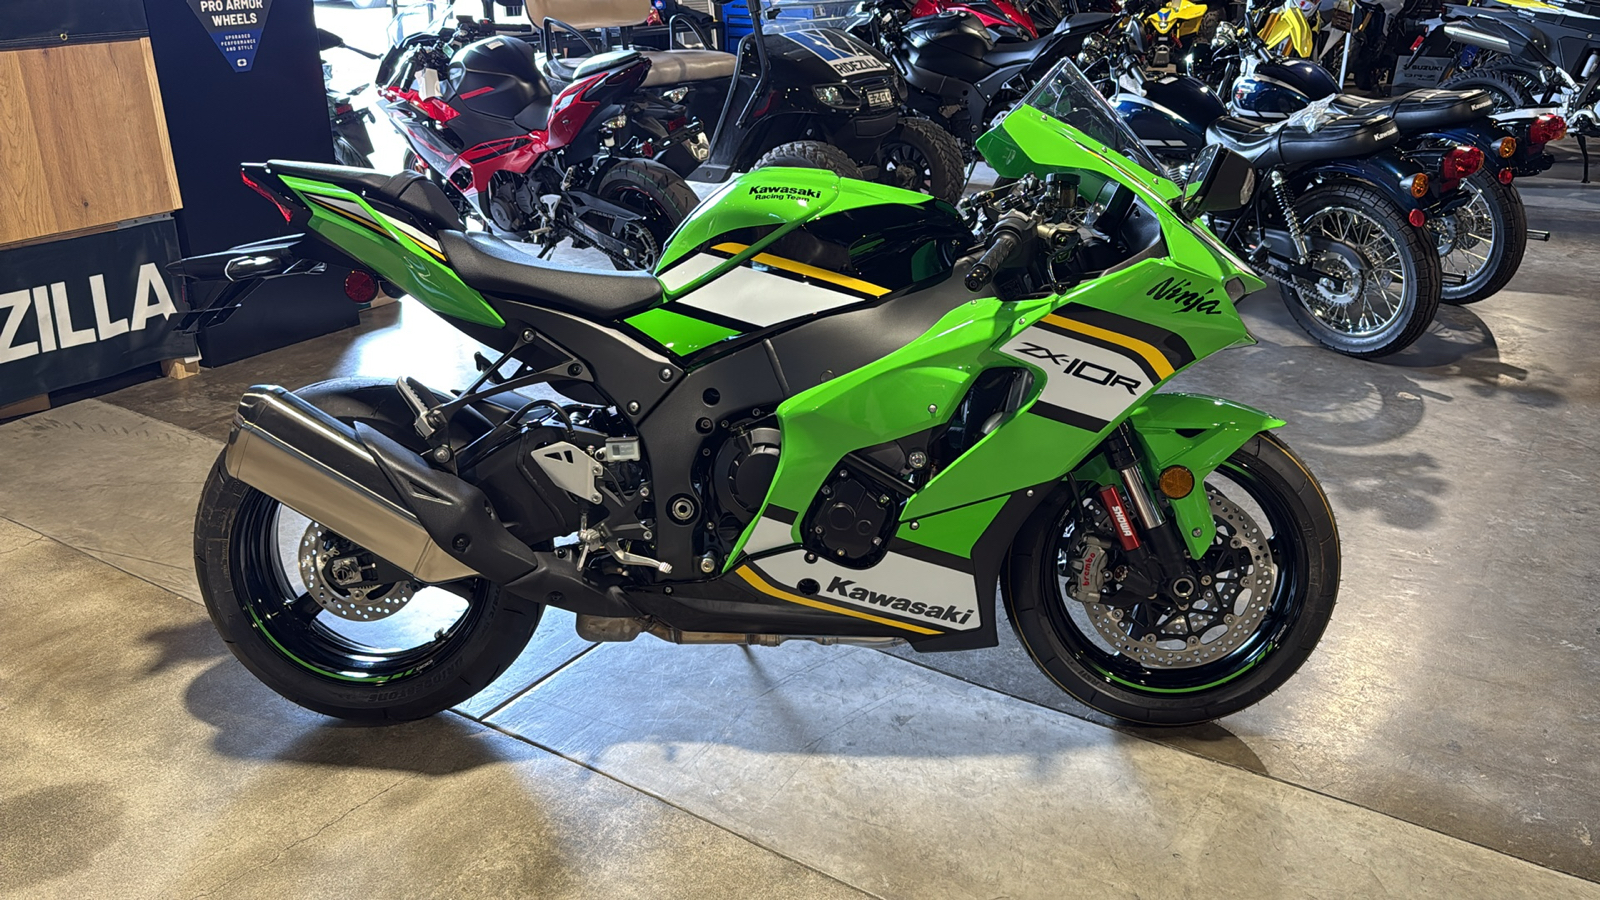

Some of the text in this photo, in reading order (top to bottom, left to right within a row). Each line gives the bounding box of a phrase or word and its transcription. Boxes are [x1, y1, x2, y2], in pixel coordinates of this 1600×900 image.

[200, 0, 263, 12] PRO ARMOR
[211, 12, 258, 27] WHEELS
[220, 38, 256, 47] PERFORMANCE
[225, 33, 251, 41] UPGRADED
[832, 58, 884, 75] RIDEZILLA
[749, 185, 821, 199] Kawasaki
[755, 193, 810, 202] Racing Team
[1146, 276, 1223, 315] Ninja
[0, 262, 178, 365] ZILLA
[1014, 341, 1142, 396] ZX-10R
[1111, 505, 1132, 537] SHOWA
[1082, 552, 1096, 586] brembo
[826, 575, 974, 625] Kawasaki
